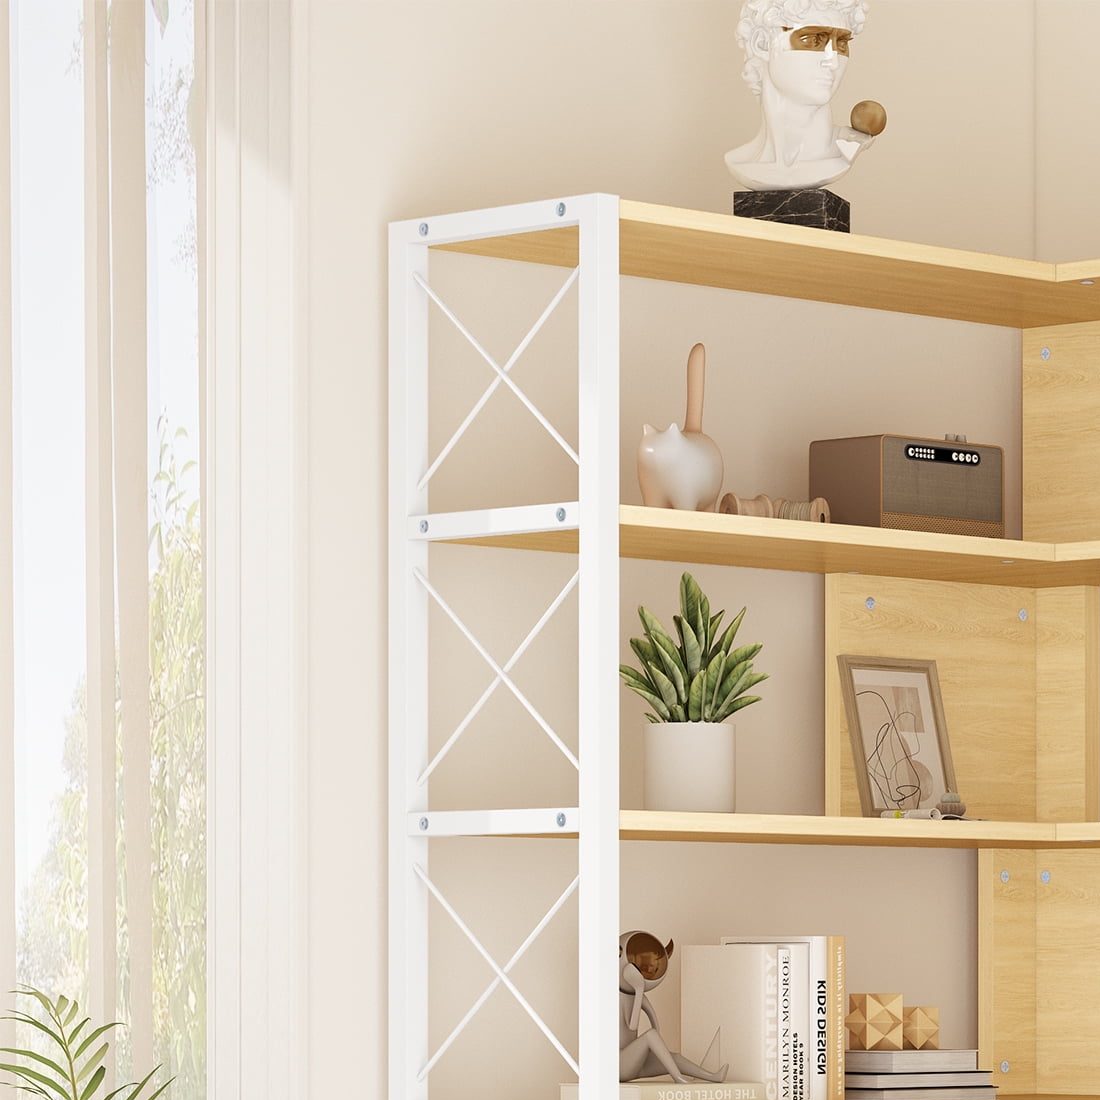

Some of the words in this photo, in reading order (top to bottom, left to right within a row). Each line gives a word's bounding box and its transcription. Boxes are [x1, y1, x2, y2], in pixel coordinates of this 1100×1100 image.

[782, 956, 790, 1022] MONROE
[695, 1089, 731, 1100] HOTEL
[736, 1089, 757, 1099] THE
